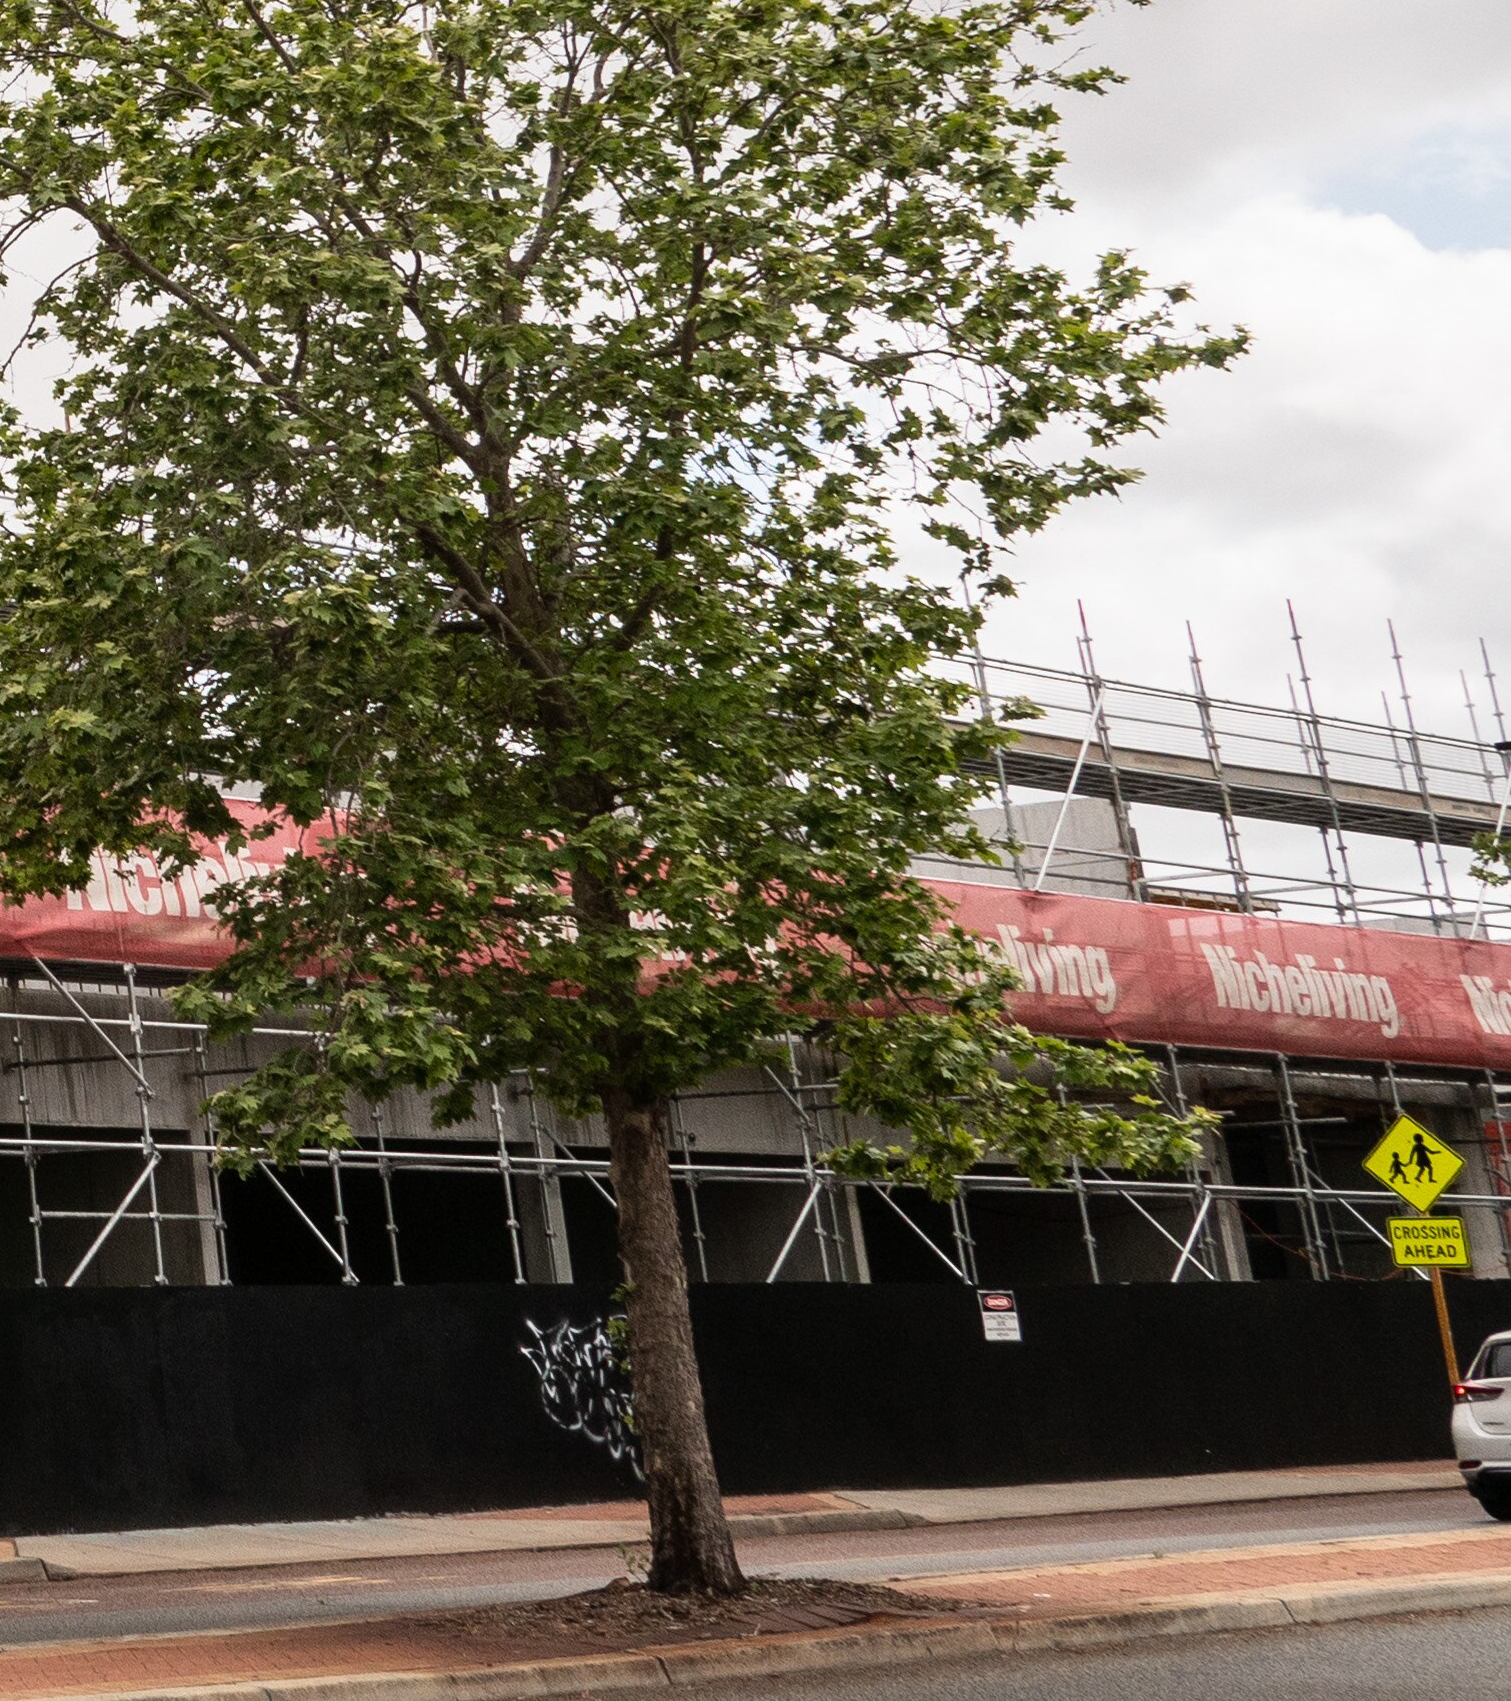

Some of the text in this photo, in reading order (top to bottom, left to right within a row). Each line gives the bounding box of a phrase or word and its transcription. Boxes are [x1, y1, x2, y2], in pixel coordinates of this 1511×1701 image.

[1200, 943, 1400, 1039] Nicheliving
[1393, 1226, 1461, 1240] CROSSING
[1404, 1245, 1457, 1258] AHEAD
